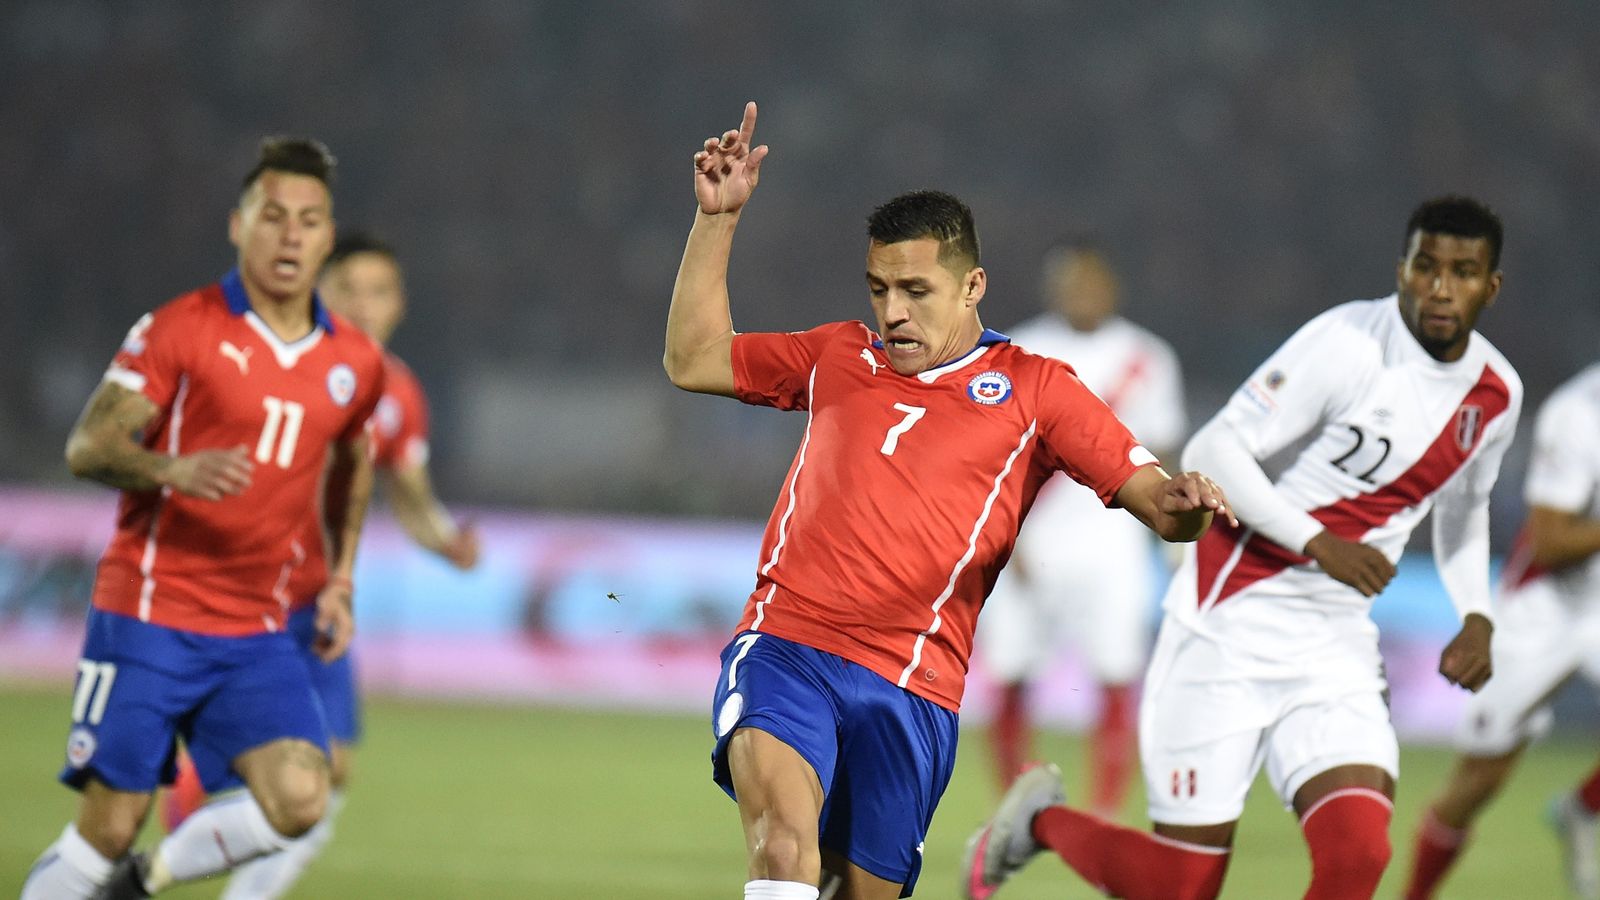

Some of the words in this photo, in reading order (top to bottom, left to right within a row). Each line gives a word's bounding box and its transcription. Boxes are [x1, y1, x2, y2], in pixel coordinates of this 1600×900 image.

[256, 395, 304, 469] 11
[880, 402, 927, 456] 7
[1330, 424, 1391, 484] 22
[72, 657, 118, 726] 11
[728, 634, 762, 691] 7
